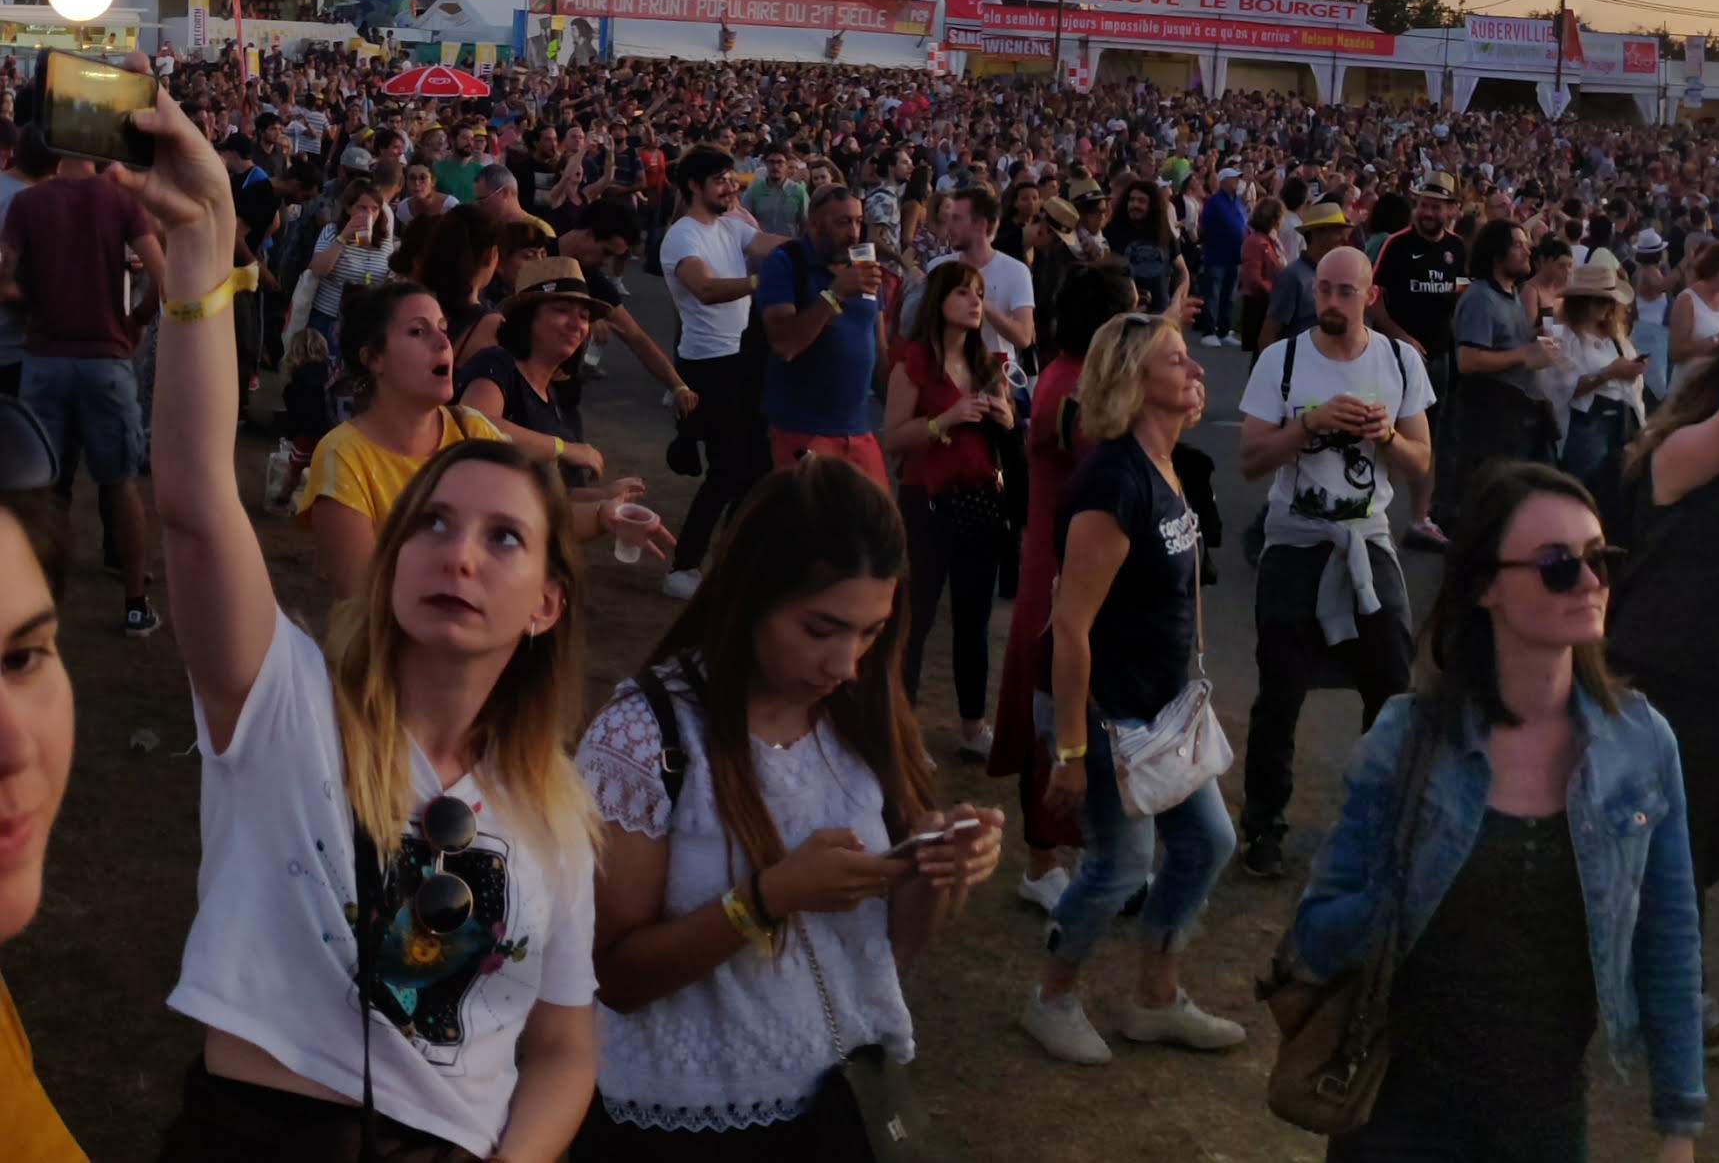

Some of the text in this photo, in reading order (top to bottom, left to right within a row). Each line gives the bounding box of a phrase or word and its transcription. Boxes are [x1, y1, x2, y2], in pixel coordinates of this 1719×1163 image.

[785, 1, 806, 23] DU
[1006, 12, 1046, 27] semble
[1051, 14, 1097, 32] tujours
[1101, 17, 1160, 34] impossible
[1205, 26, 1217, 37] ce
[1251, 31, 1258, 43] y
[1301, 31, 1334, 46] Nelson
[1337, 34, 1376, 50] Mandela
[1471, 20, 1557, 43] AUBERVILLIE
[1410, 279, 1453, 293] Emirate
[1429, 269, 1444, 281] Fly
